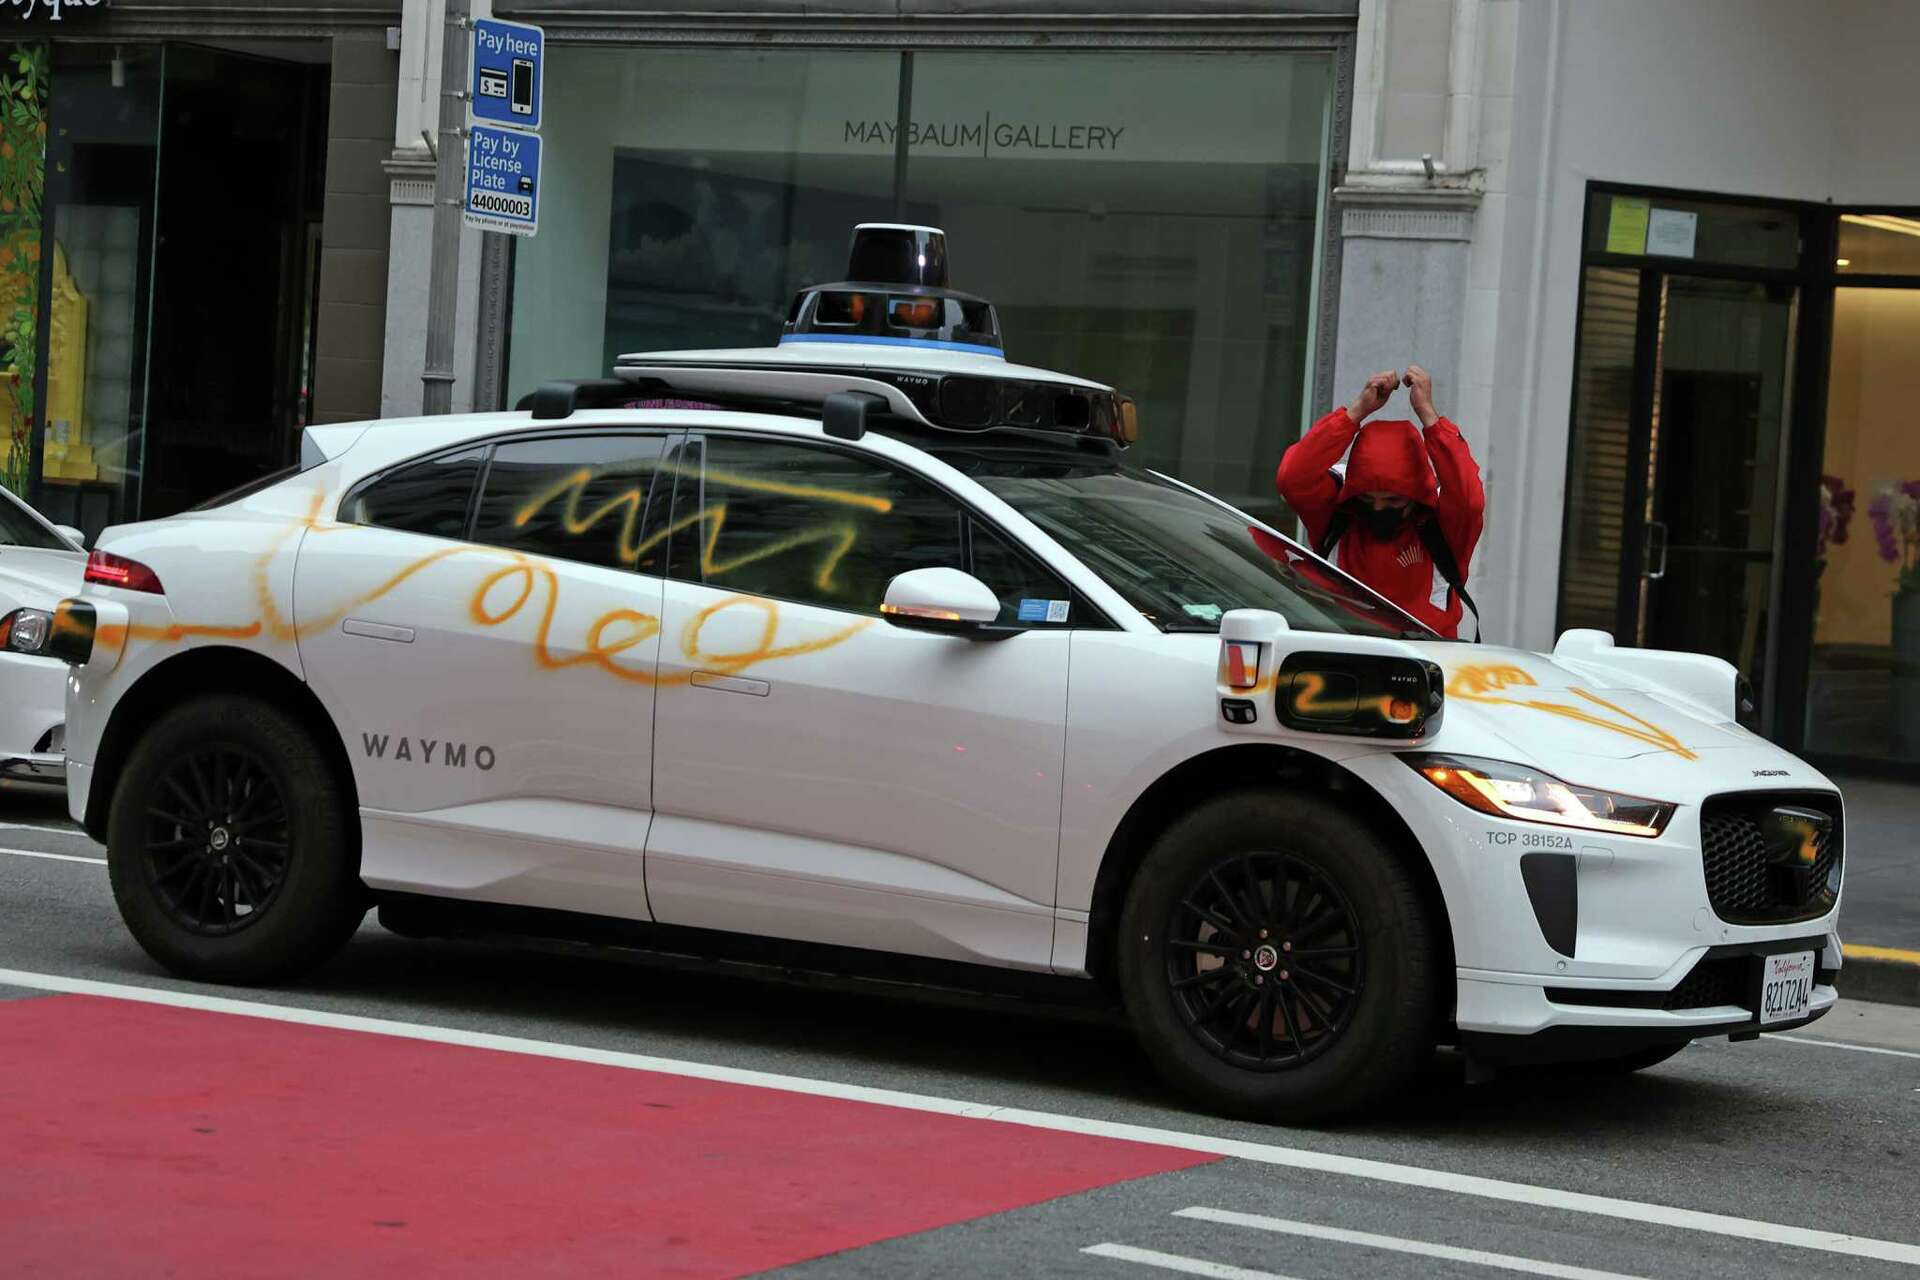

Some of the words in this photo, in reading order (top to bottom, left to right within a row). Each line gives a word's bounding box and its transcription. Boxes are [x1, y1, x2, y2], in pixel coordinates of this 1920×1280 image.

[478, 29, 504, 54] Pay
[506, 33, 538, 56] here
[474, 131, 499, 155] Pay
[502, 136, 520, 158] by
[994, 124, 1124, 149] GALLERY
[473, 150, 522, 173] License
[472, 169, 506, 189] Plate
[471, 194, 530, 216] 44000003
[897, 376, 928, 384] WAYMO
[362, 732, 496, 771] WAYMO
[1486, 831, 1517, 845] TCP
[1522, 833, 1573, 849] 38152A
